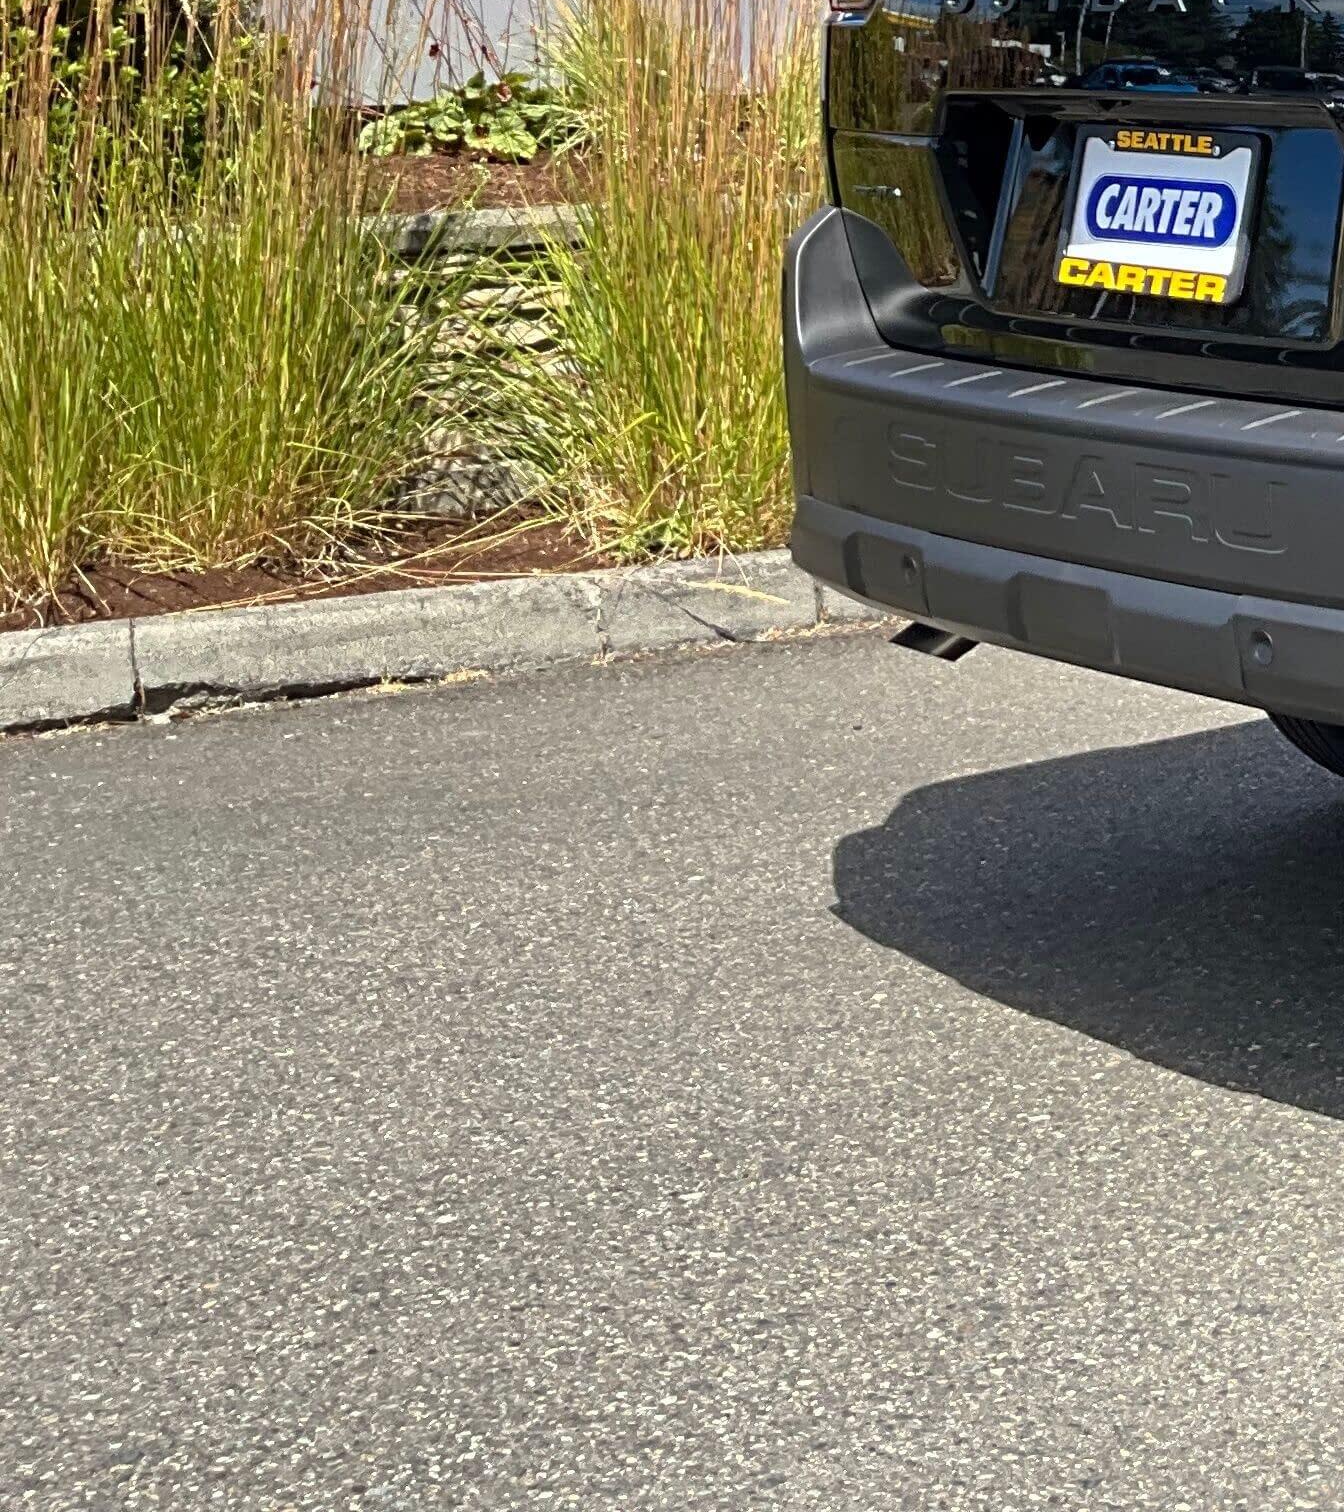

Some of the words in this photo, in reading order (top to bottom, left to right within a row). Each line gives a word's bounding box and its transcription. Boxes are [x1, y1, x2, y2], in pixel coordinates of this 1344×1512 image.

[1116, 130, 1213, 155] SEATTLE
[1095, 183, 1223, 238] CARTER
[1058, 257, 1228, 303] CARTER
[887, 421, 1290, 554] SUBARU
